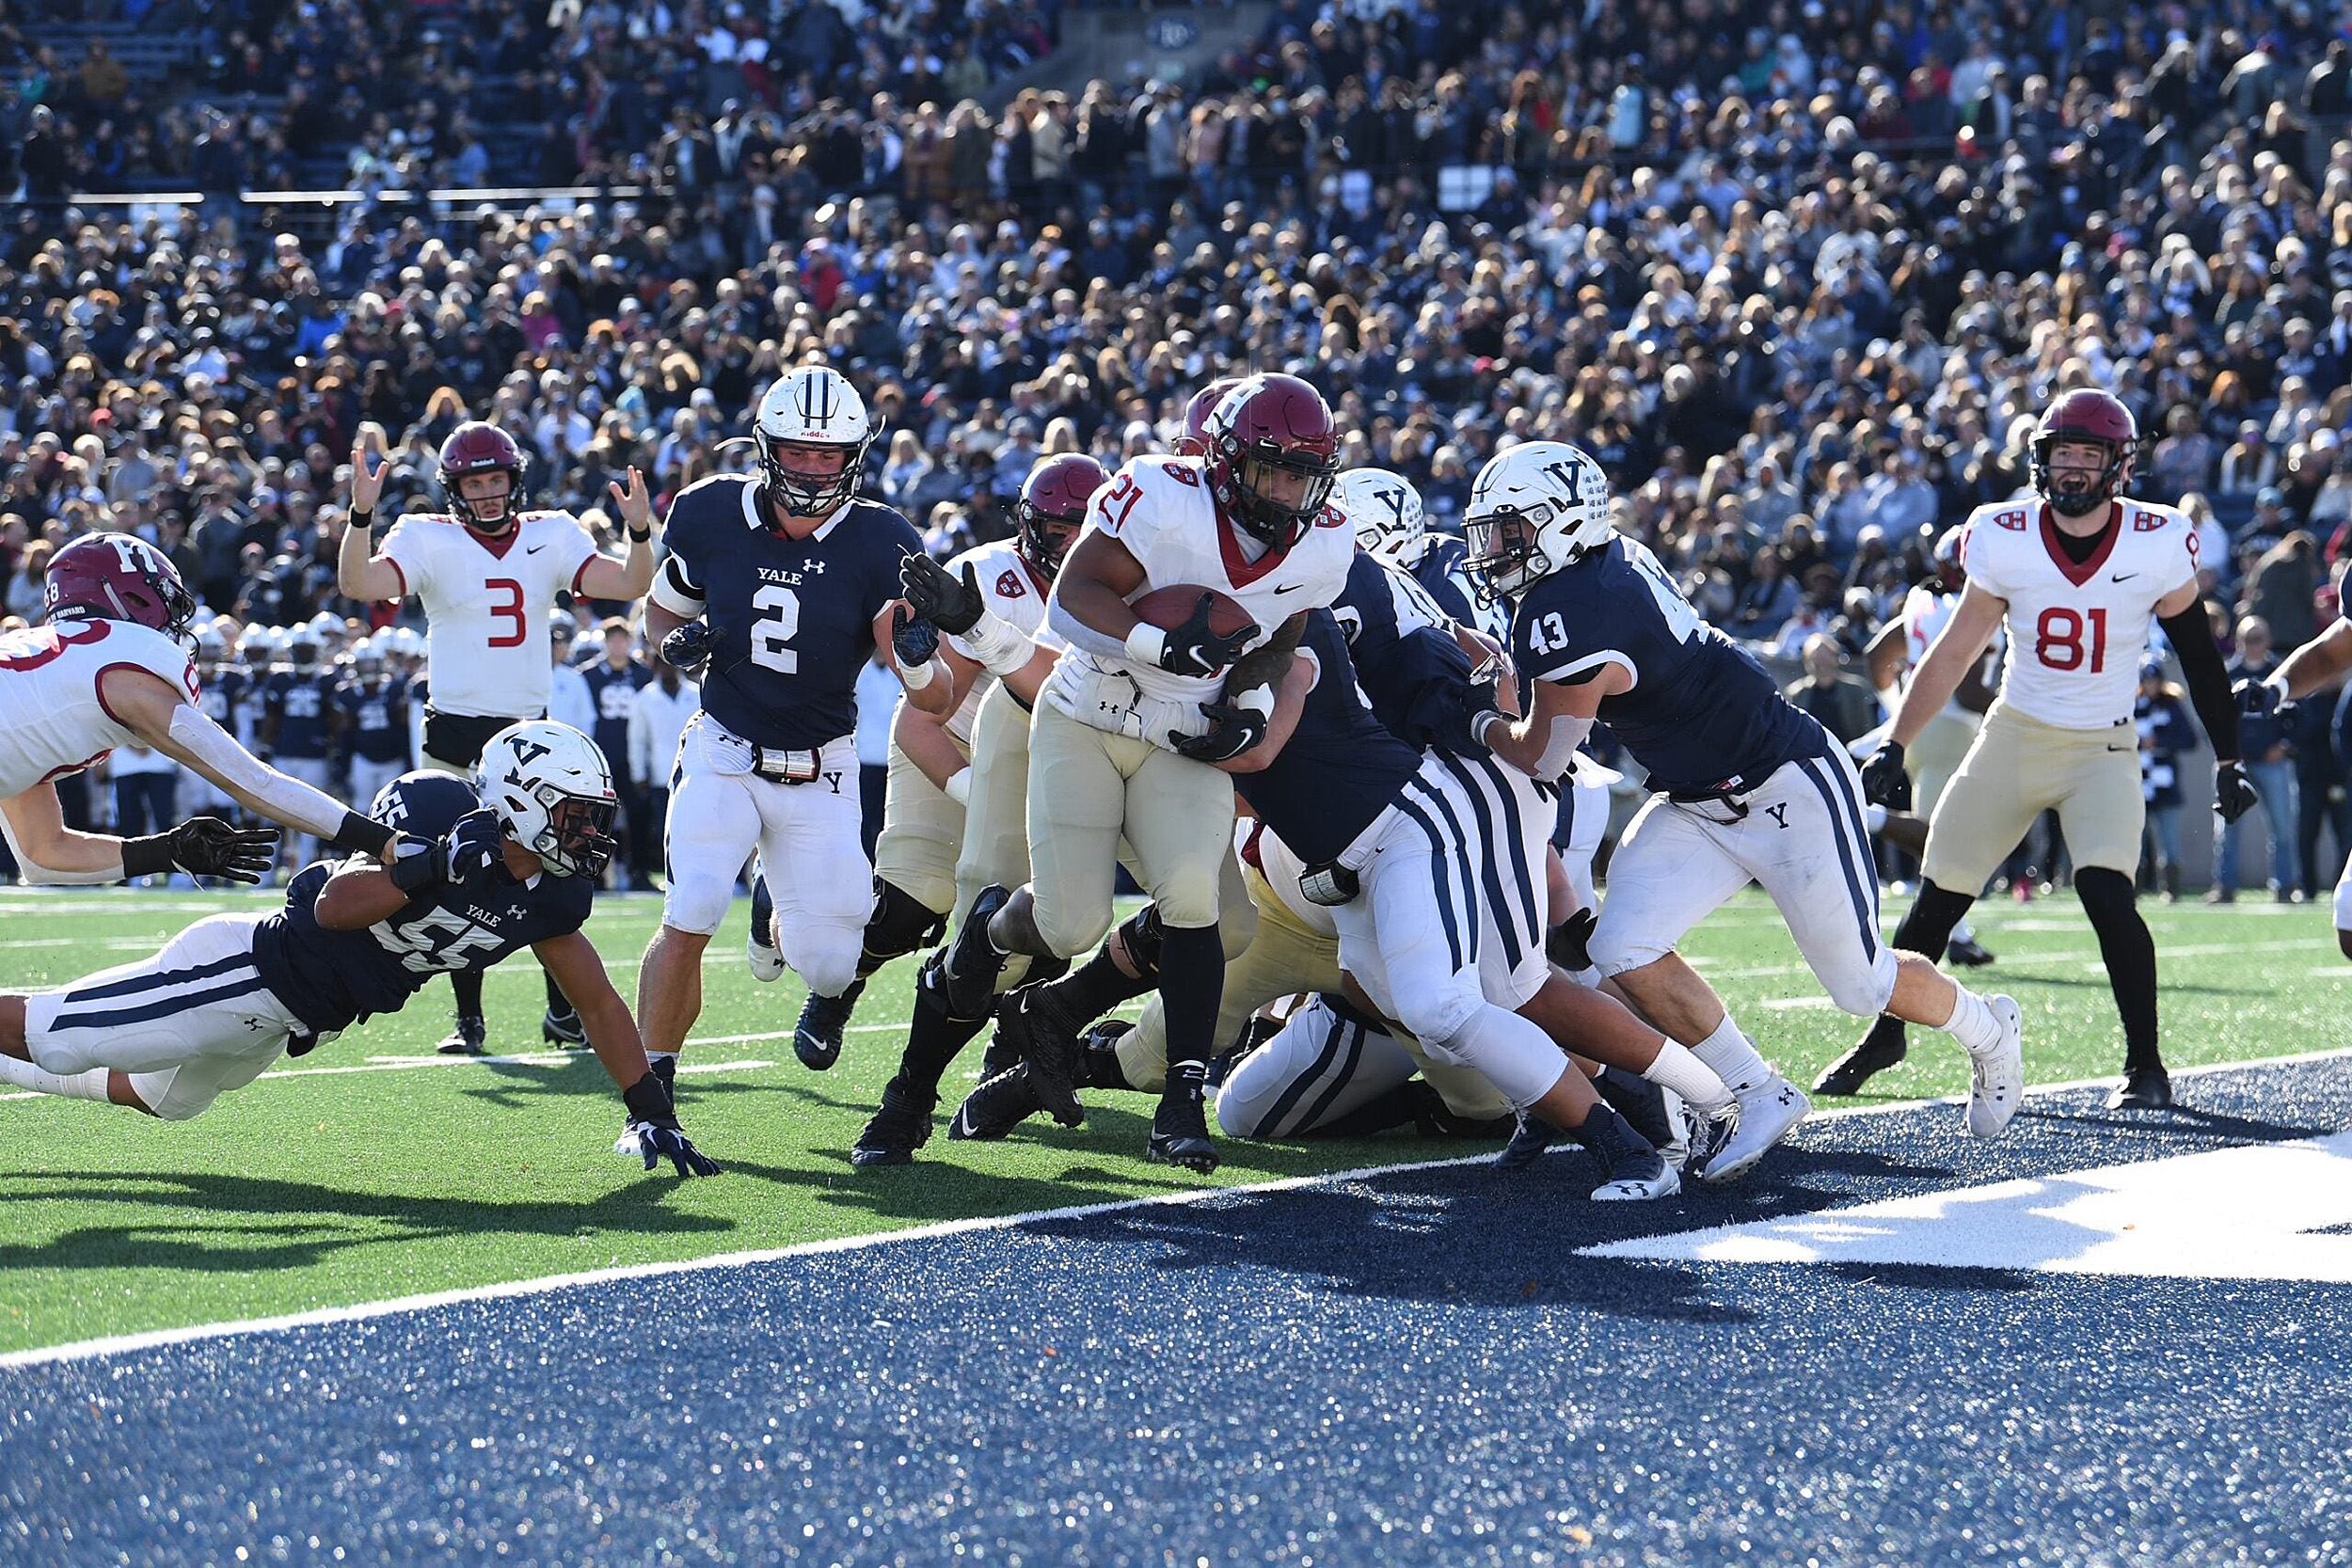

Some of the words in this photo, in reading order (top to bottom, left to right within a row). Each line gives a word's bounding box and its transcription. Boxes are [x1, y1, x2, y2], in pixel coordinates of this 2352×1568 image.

[1098, 474, 1144, 533] 21
[1549, 460, 1584, 508] Y
[1373, 489, 1406, 531] Y
[103, 535, 158, 573] H
[756, 566, 803, 586] YALE
[56, 606, 86, 619] HARVARD
[485, 578, 527, 648] 3
[751, 584, 801, 674] 2
[1529, 610, 1569, 657] 43
[2036, 607, 2106, 673] 81
[502, 736, 551, 786] Y
[822, 771, 843, 794] Y
[371, 789, 409, 828] 55
[1765, 801, 1788, 830] Y
[465, 904, 502, 928] YALE
[368, 904, 506, 974] 55
